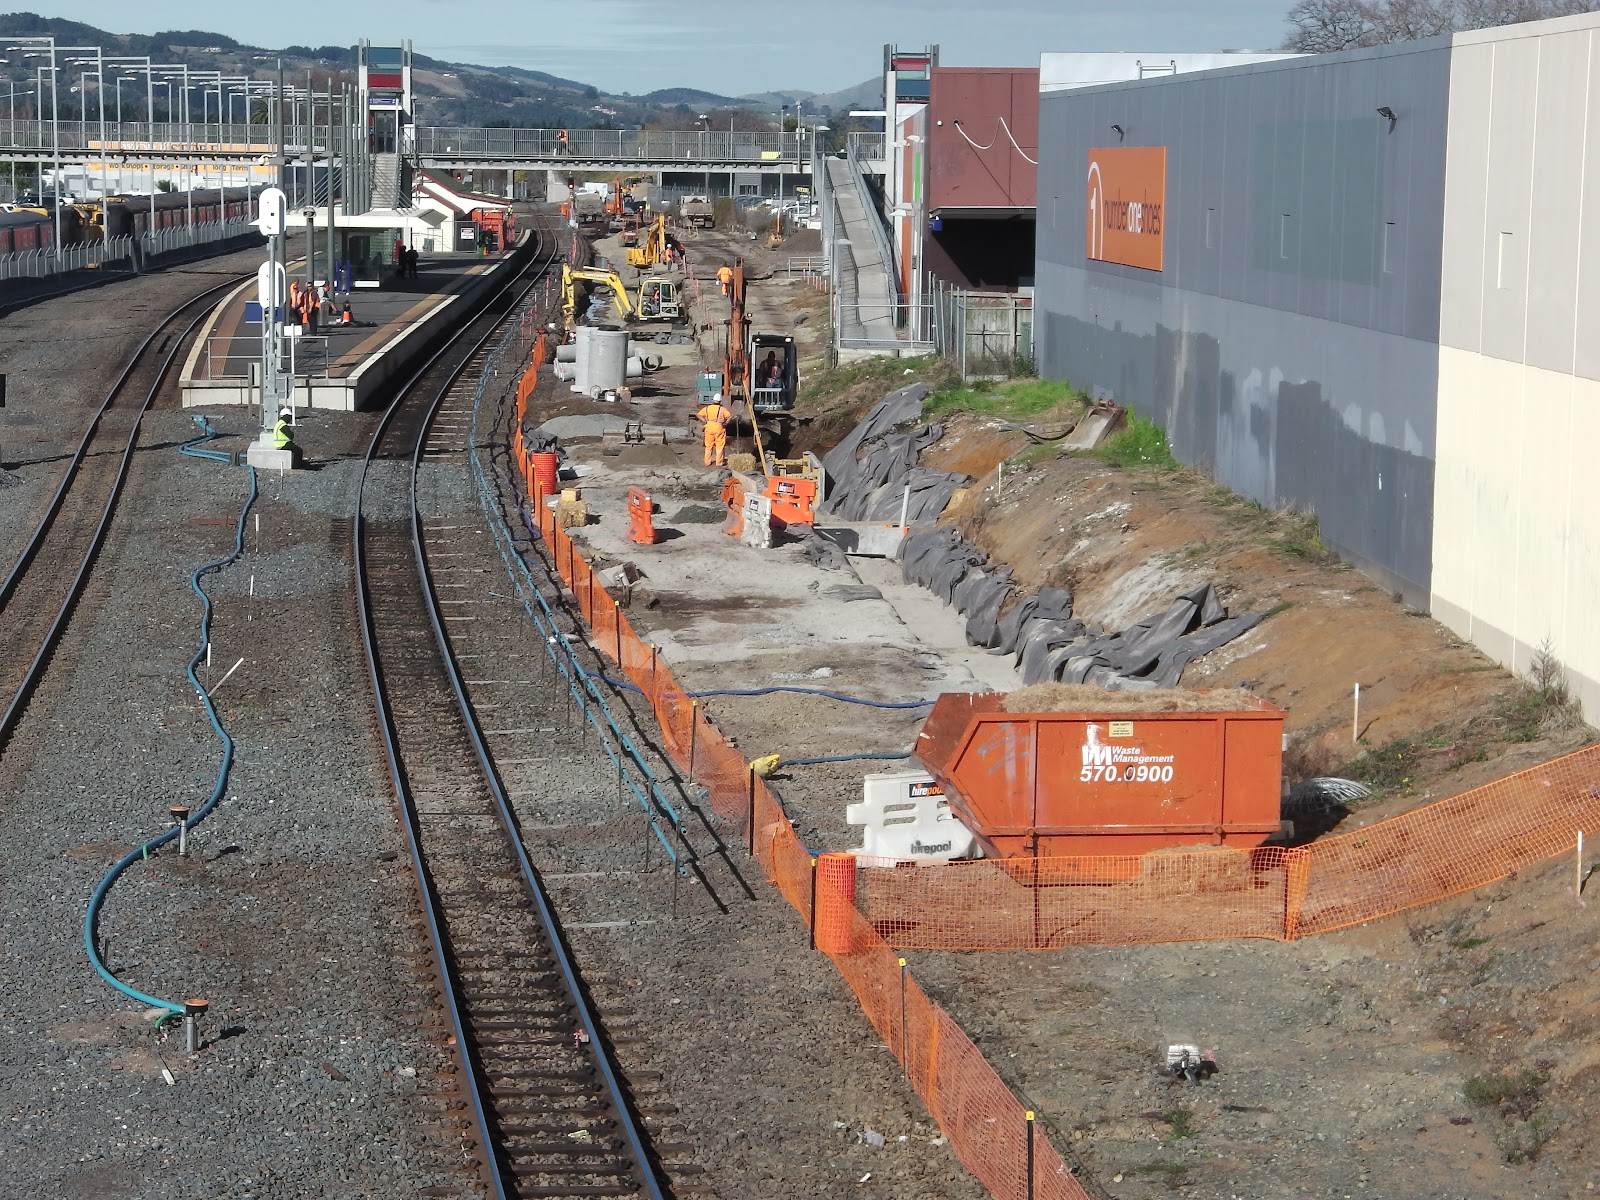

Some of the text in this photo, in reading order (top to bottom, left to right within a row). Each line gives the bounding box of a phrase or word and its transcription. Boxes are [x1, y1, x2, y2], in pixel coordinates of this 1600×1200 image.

[108, 162, 143, 170] Wokshops
[152, 163, 174, 171] torage
[1112, 746, 1141, 755] Waste
[1113, 755, 1175, 765] Management
[1080, 765, 1174, 782] 570.0900
[911, 783, 943, 797] hirepoo
[910, 840, 952, 855] hirepool
